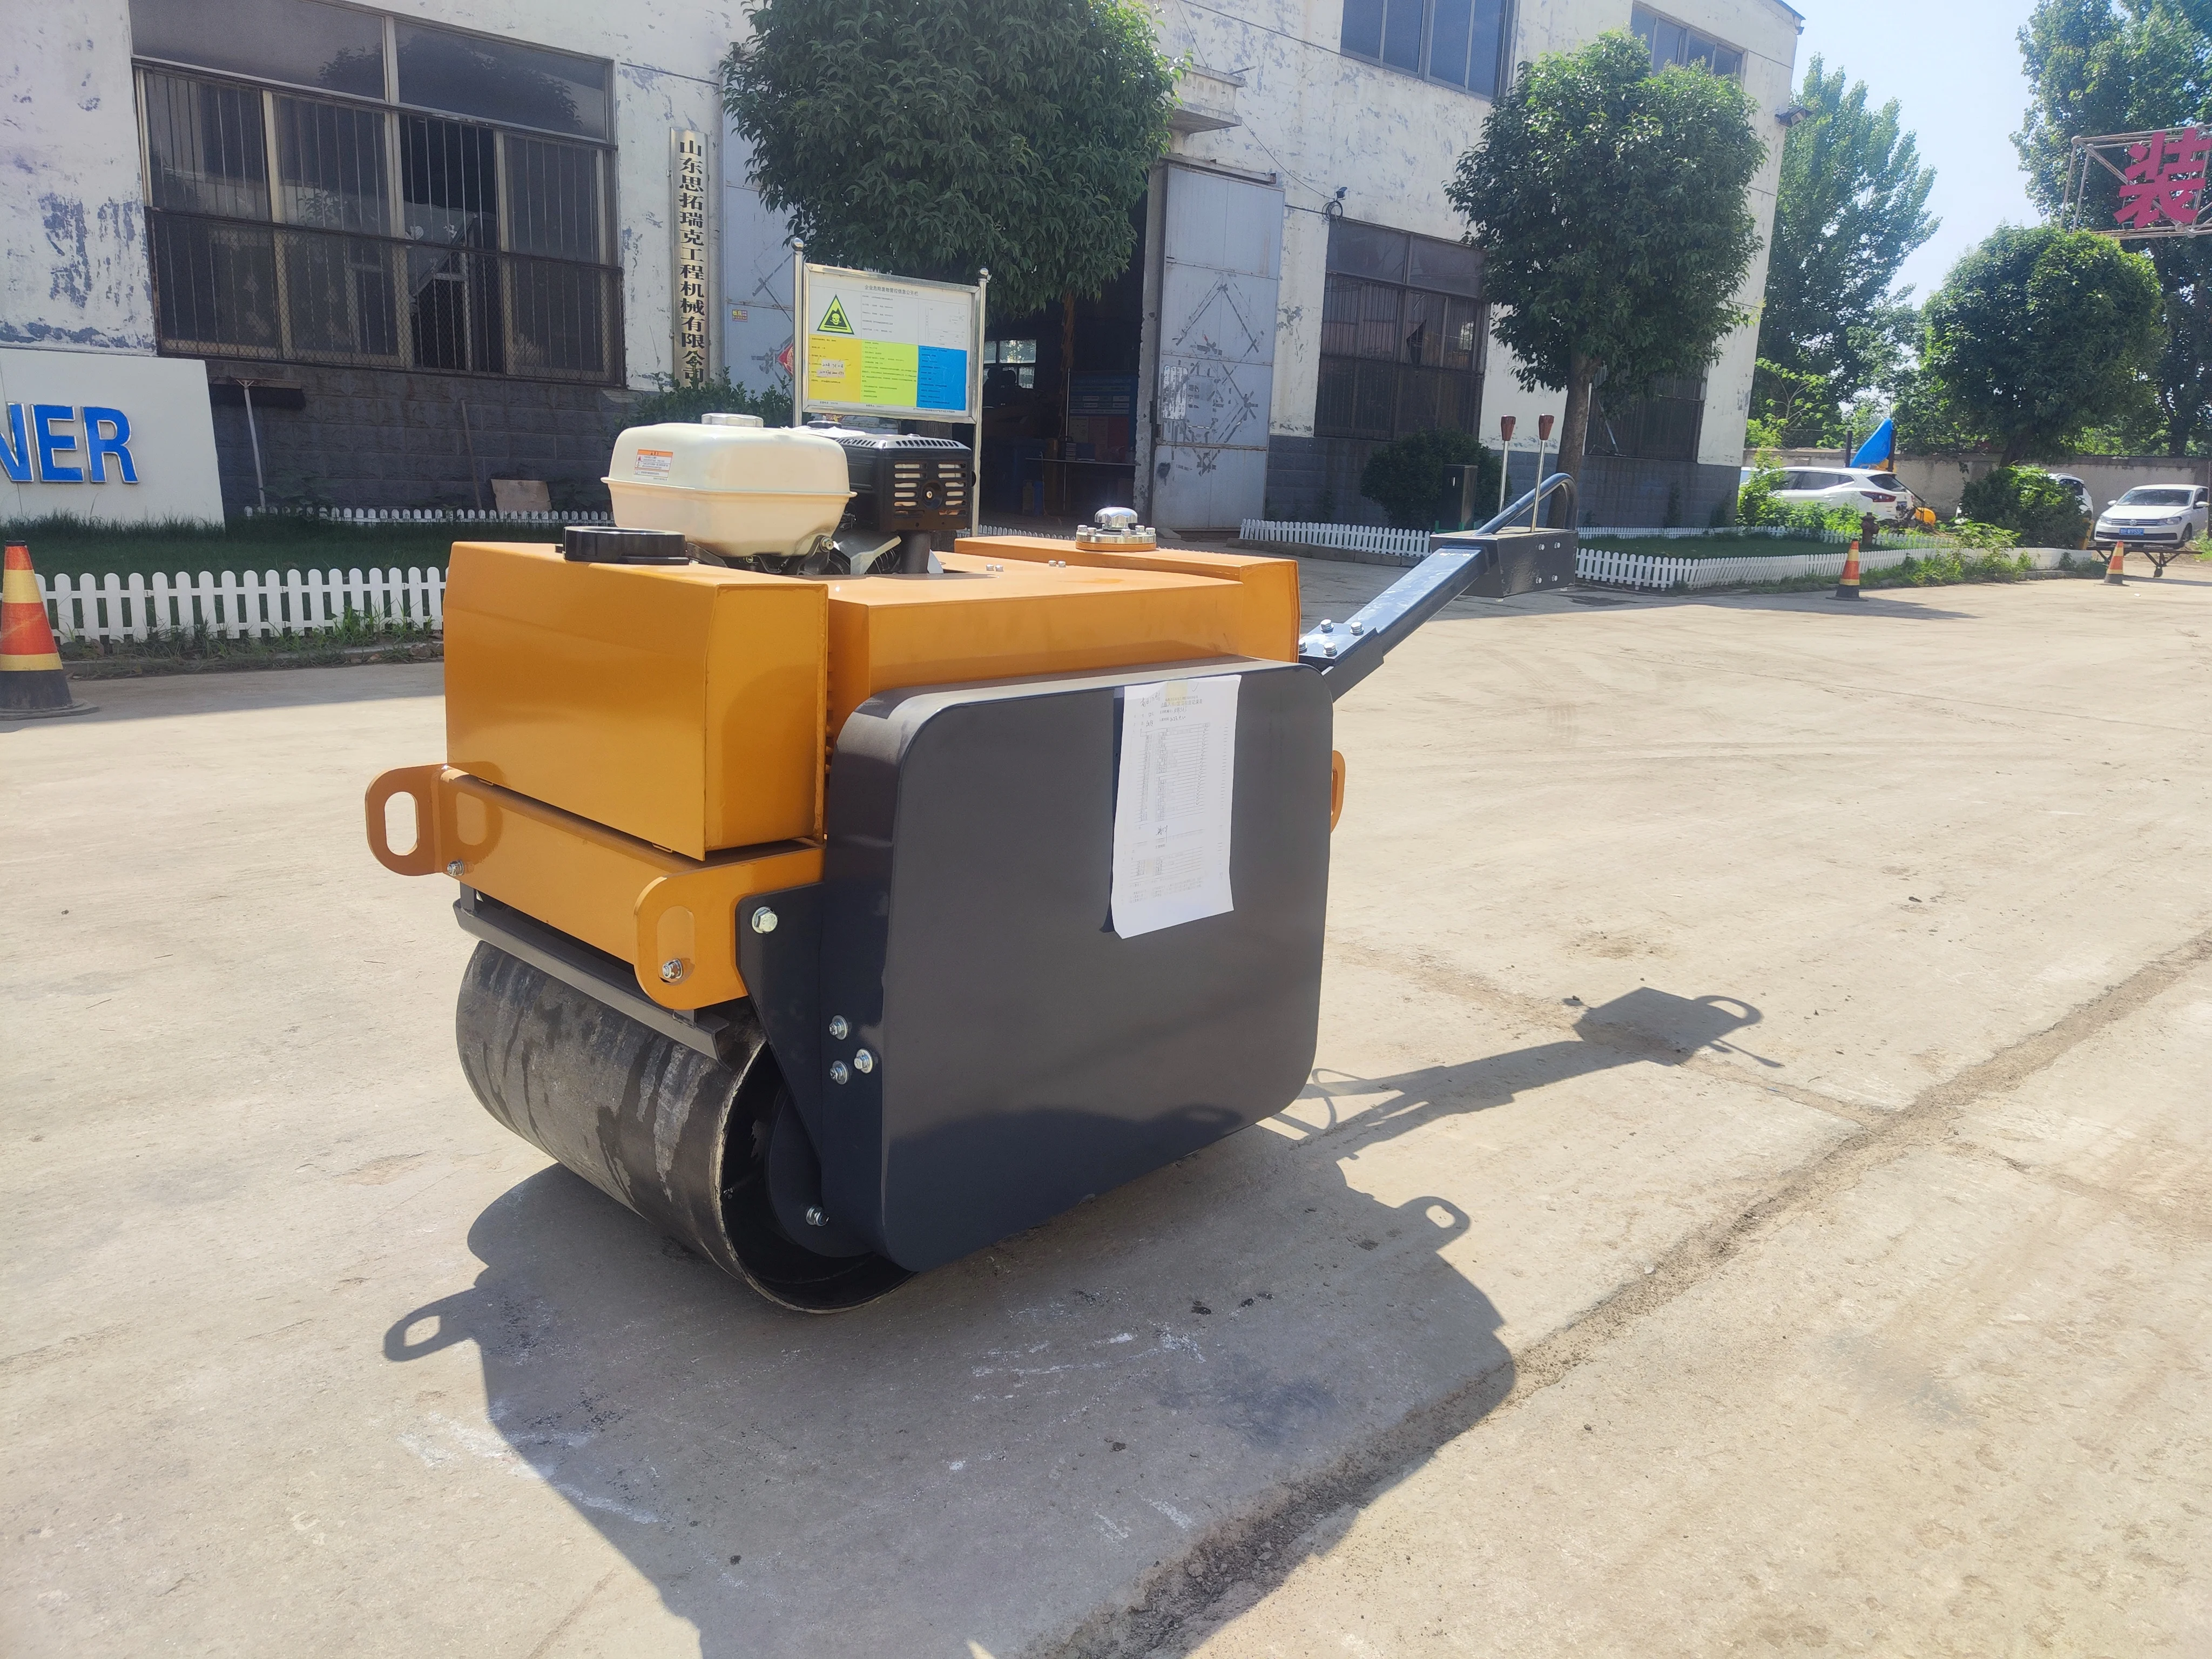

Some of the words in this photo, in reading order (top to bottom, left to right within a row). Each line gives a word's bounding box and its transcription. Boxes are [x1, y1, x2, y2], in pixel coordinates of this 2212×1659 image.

[679, 140, 705, 383] 山东思拓瑞克工程机械有限公司
